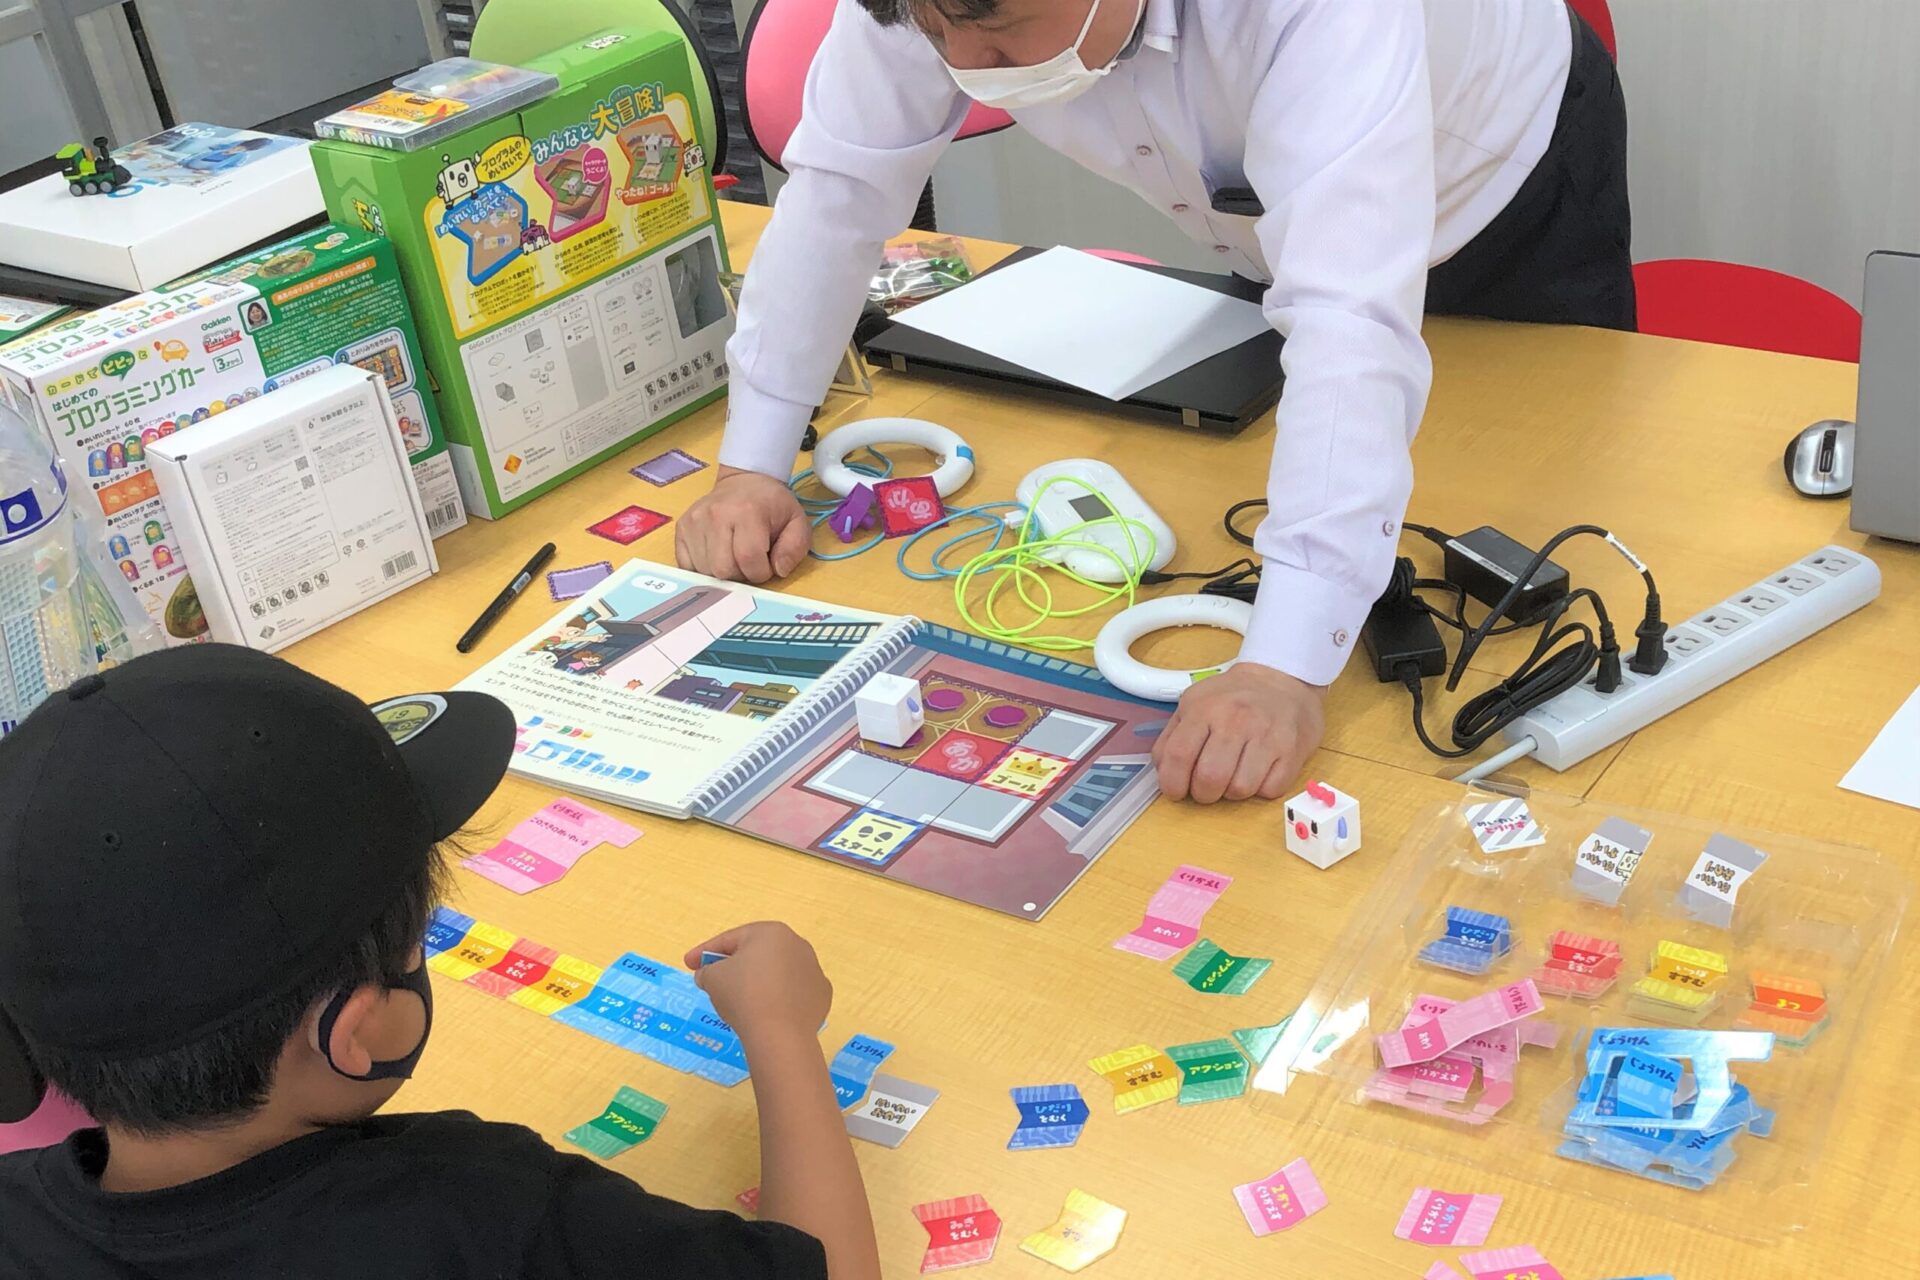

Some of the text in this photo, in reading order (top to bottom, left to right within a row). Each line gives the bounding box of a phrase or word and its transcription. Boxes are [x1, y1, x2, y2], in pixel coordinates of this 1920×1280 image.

[481, 140, 522, 171] プログラムの
[487, 152, 523, 180] めいれいで
[51, 388, 99, 412] はじめての
[57, 366, 206, 437] プログラミングカー
[944, 739, 982, 772] あか
[991, 774, 1037, 792] ゴール
[833, 838, 885, 858] スタート
[1179, 872, 1220, 889] くりかえし
[1153, 926, 1181, 939] おわり
[1461, 926, 1495, 940] ひだり
[460, 948, 486, 964] すすむ
[1572, 952, 1600, 964] みぎ
[621, 957, 657, 978] じょうけん
[1676, 964, 1708, 978] いっぽ
[1668, 971, 1706, 988] すすむ
[545, 982, 573, 999] すすむ
[1776, 998, 1801, 1011] まつ
[699, 1013, 733, 1034] じょうけん
[850, 1039, 886, 1059] じょうけん
[1598, 1034, 1650, 1047] じょうけん
[1124, 1061, 1155, 1077] いっぽ
[1189, 1060, 1244, 1076] アクション
[1629, 1056, 1676, 1083] じょうけん
[1126, 1070, 1163, 1086] すすむ
[1034, 1103, 1073, 1114] ひだり
[604, 1111, 646, 1136] アクション
[1039, 1113, 1067, 1124] をむく
[1256, 1185, 1283, 1220] くりかえす
[1271, 1183, 1294, 1213] 2かい
[949, 1216, 976, 1229] みぎ
[1419, 1196, 1446, 1235] くりかえす
[950, 1228, 980, 1241] をむく
